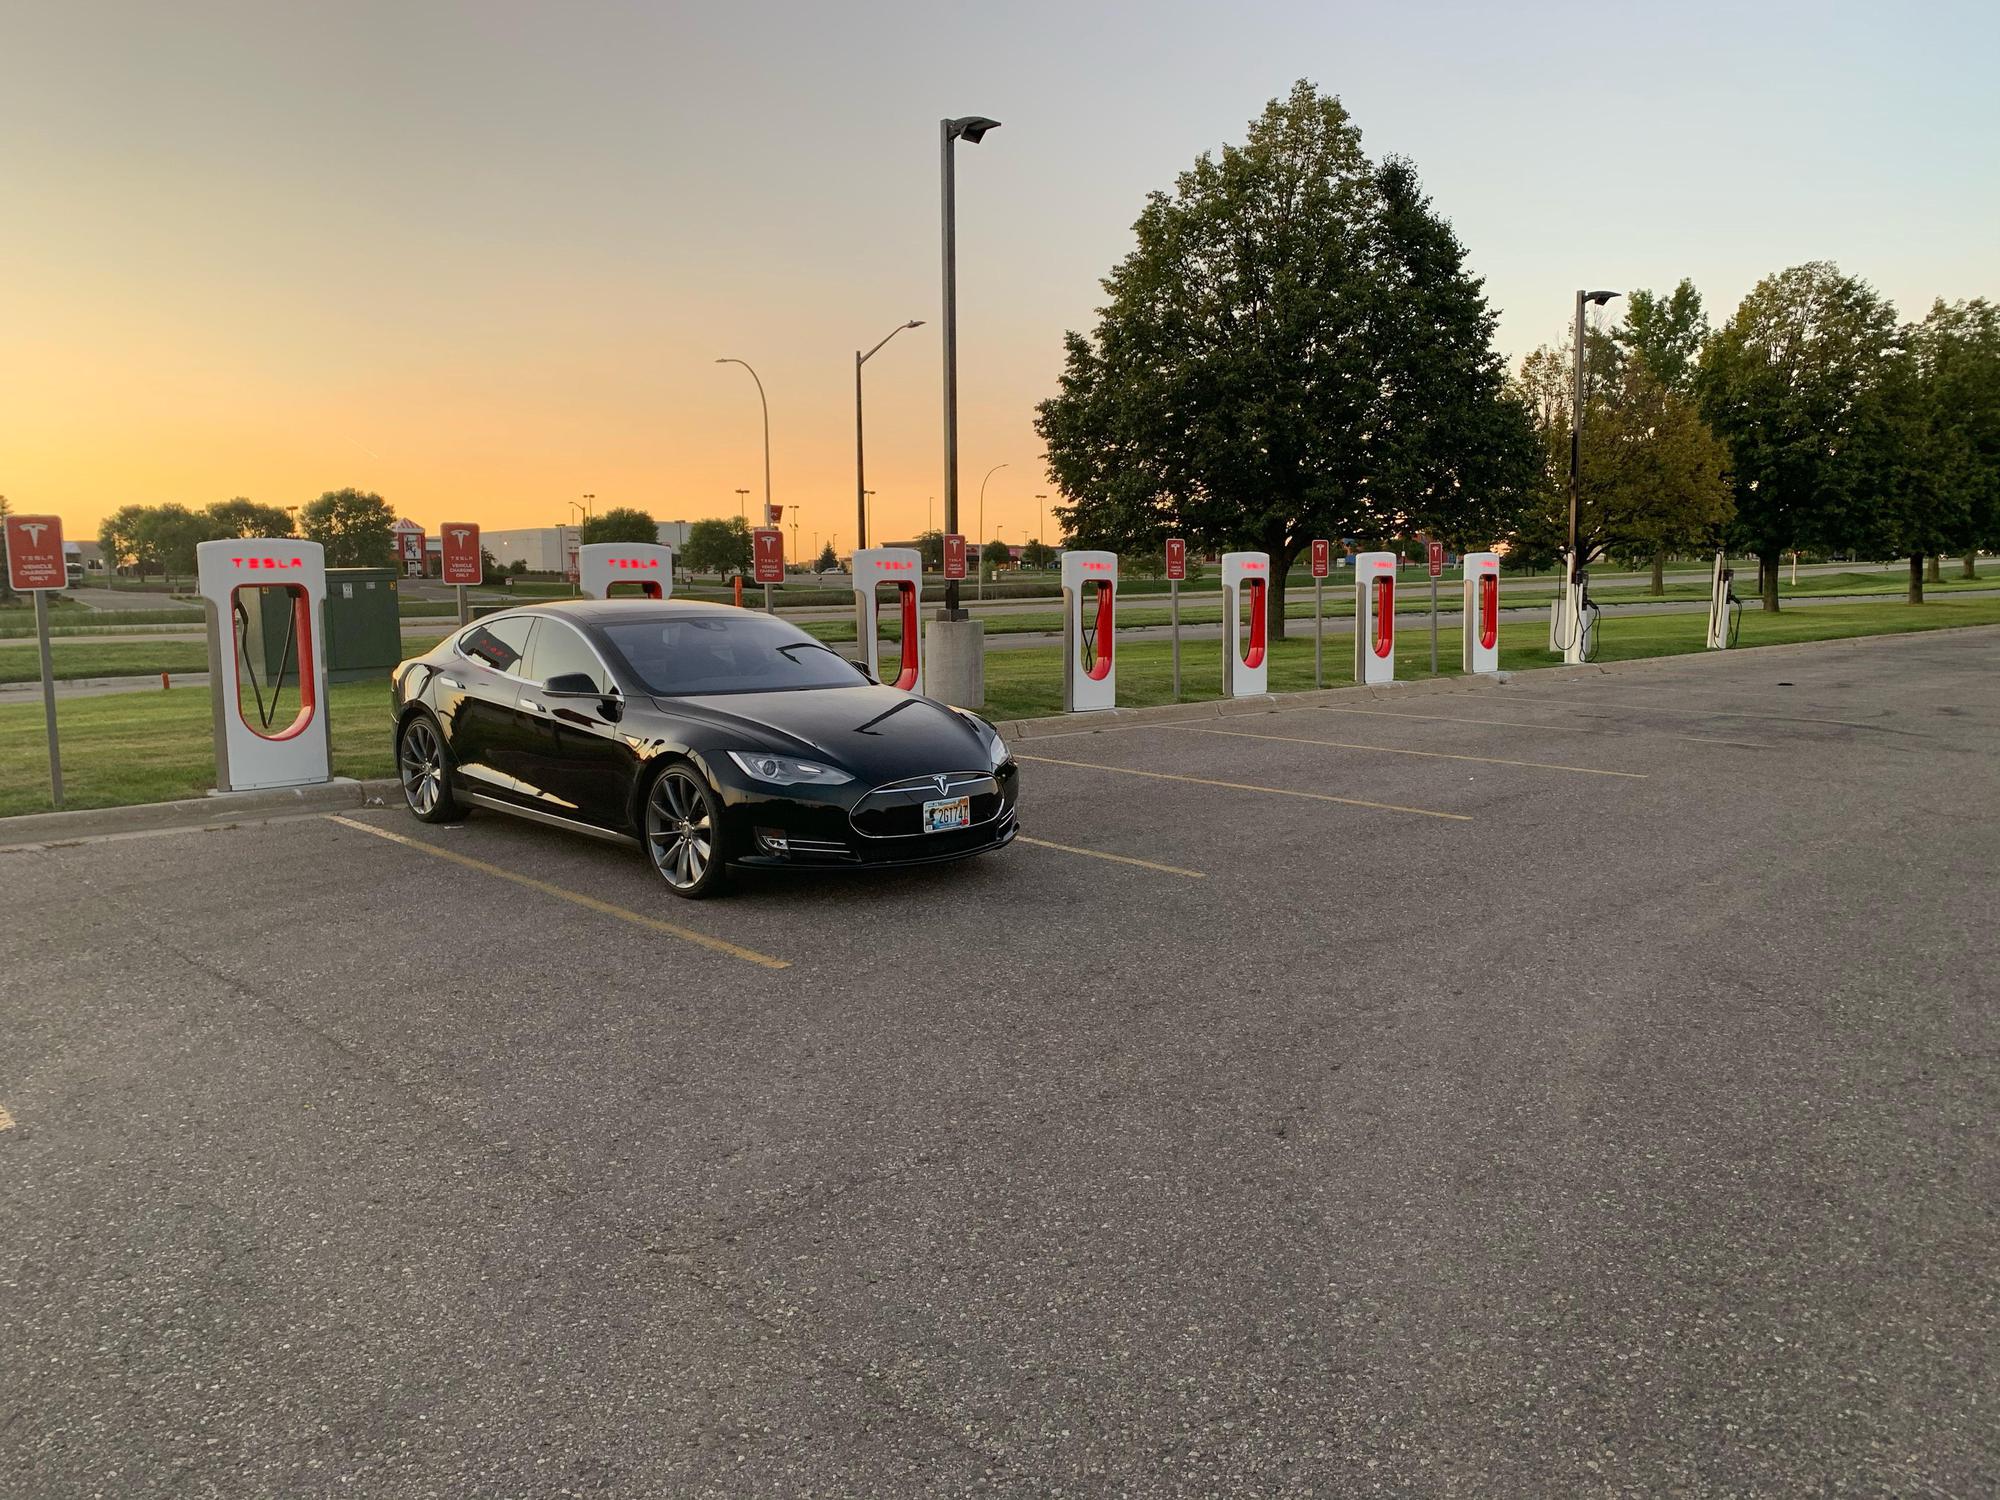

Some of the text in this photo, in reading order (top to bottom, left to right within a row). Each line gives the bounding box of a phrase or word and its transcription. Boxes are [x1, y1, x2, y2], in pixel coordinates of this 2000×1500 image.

[230, 557, 303, 569] TESLA
[607, 559, 659, 569] TESLA
[874, 561, 913, 570] TESLA
